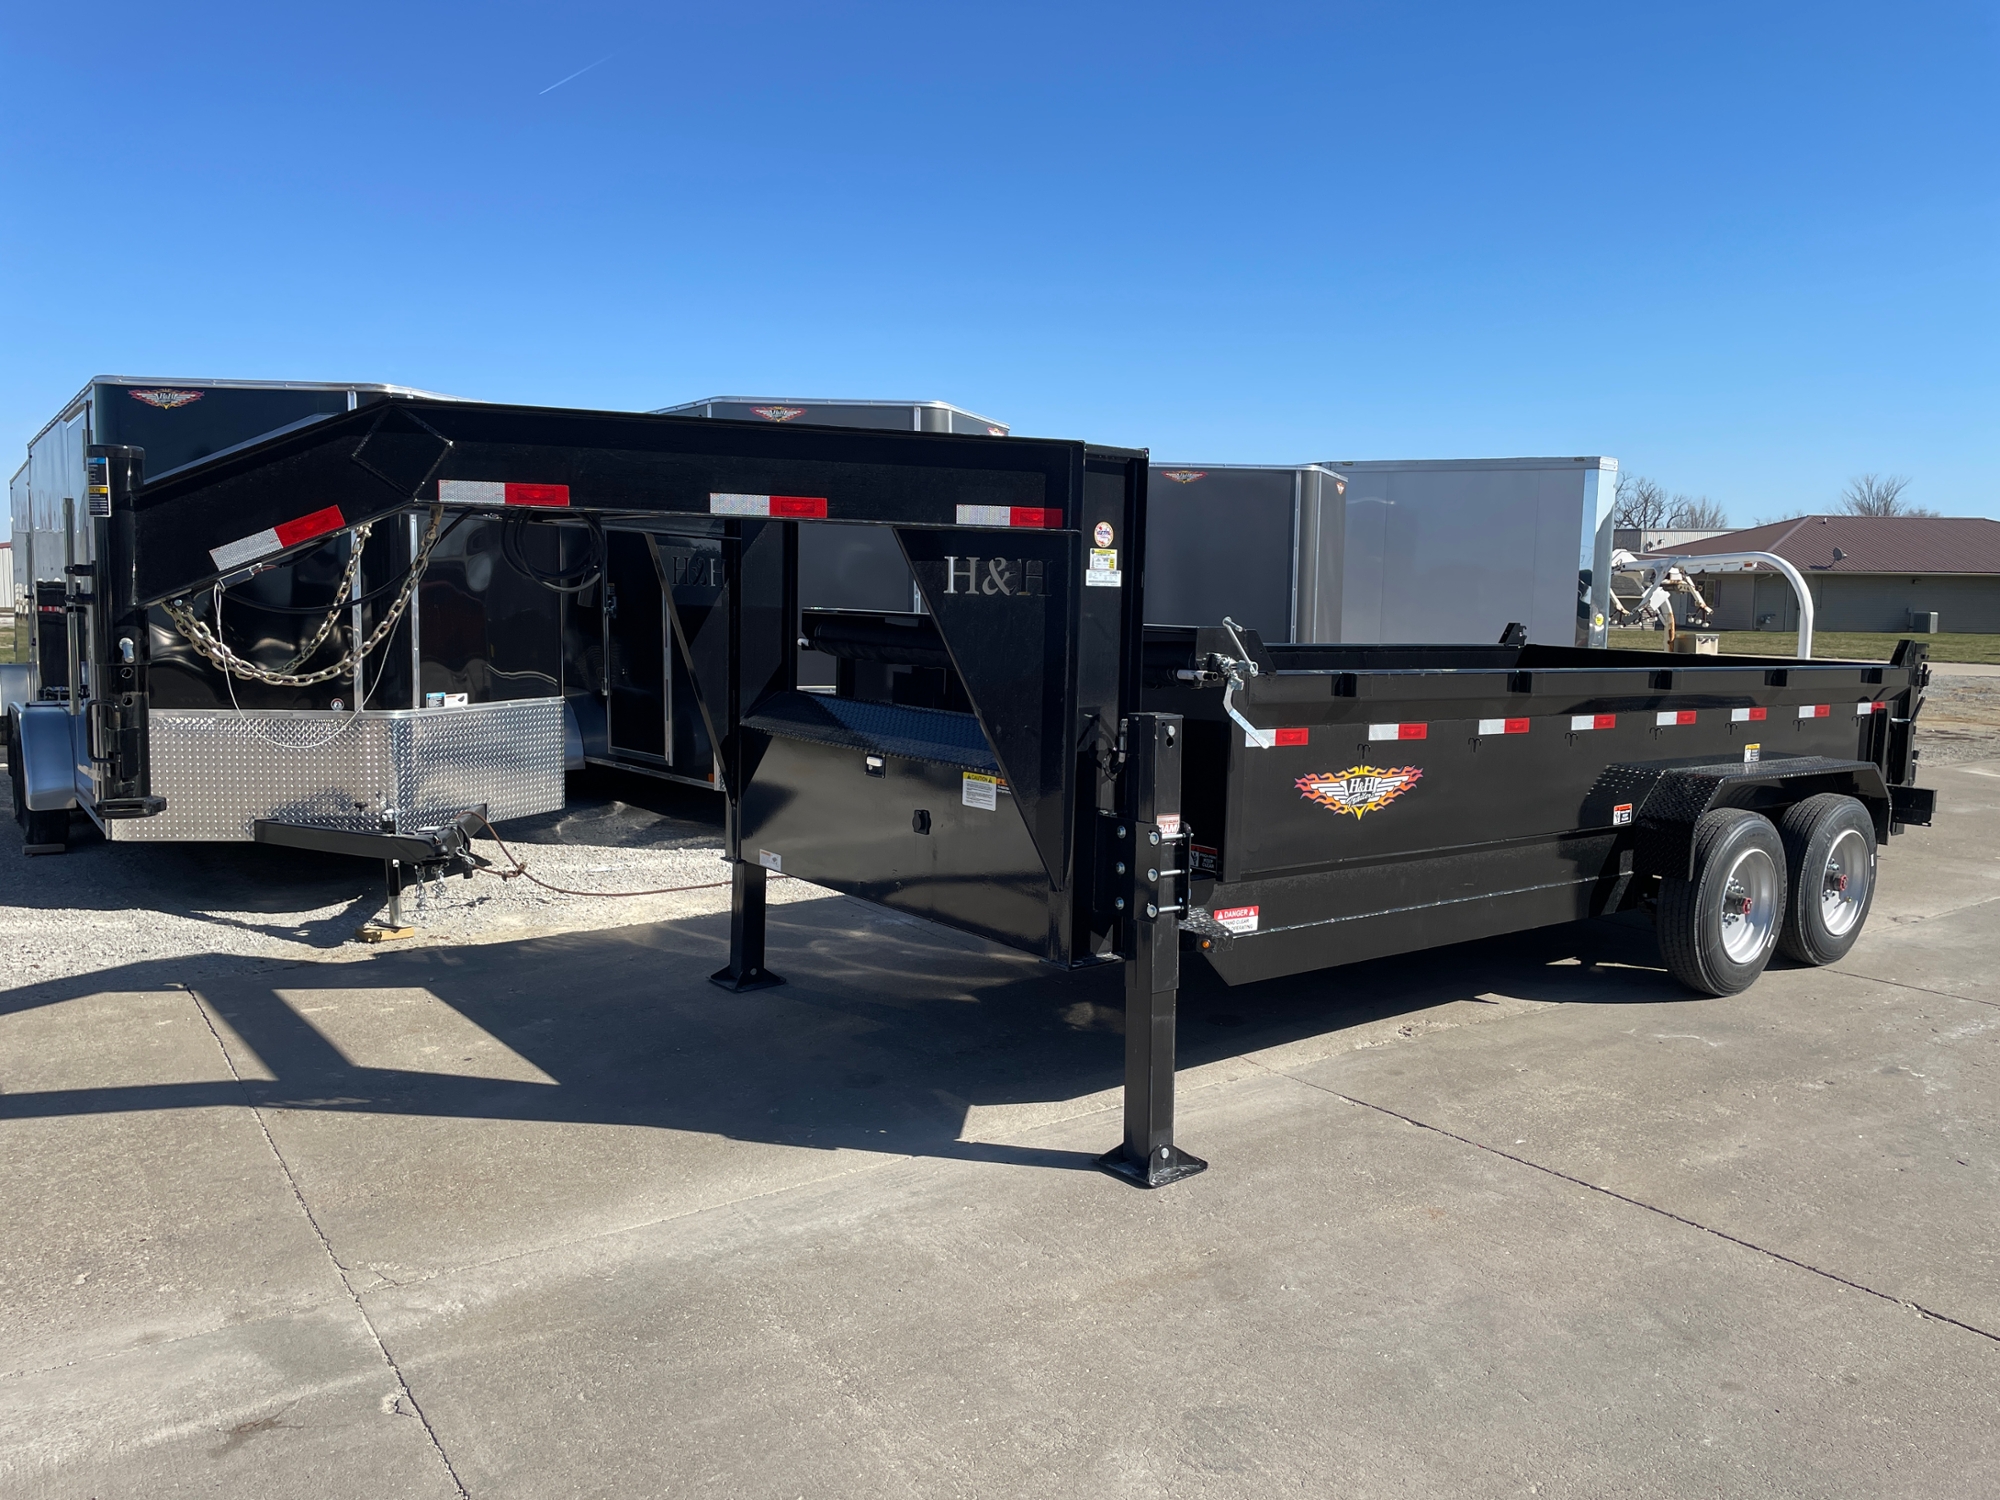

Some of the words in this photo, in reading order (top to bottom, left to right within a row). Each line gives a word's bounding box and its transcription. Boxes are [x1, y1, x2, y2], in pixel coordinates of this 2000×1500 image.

[943, 555, 1053, 597] H&H
[1349, 777, 1376, 793] H&H
[1224, 909, 1248, 918] DANGER
